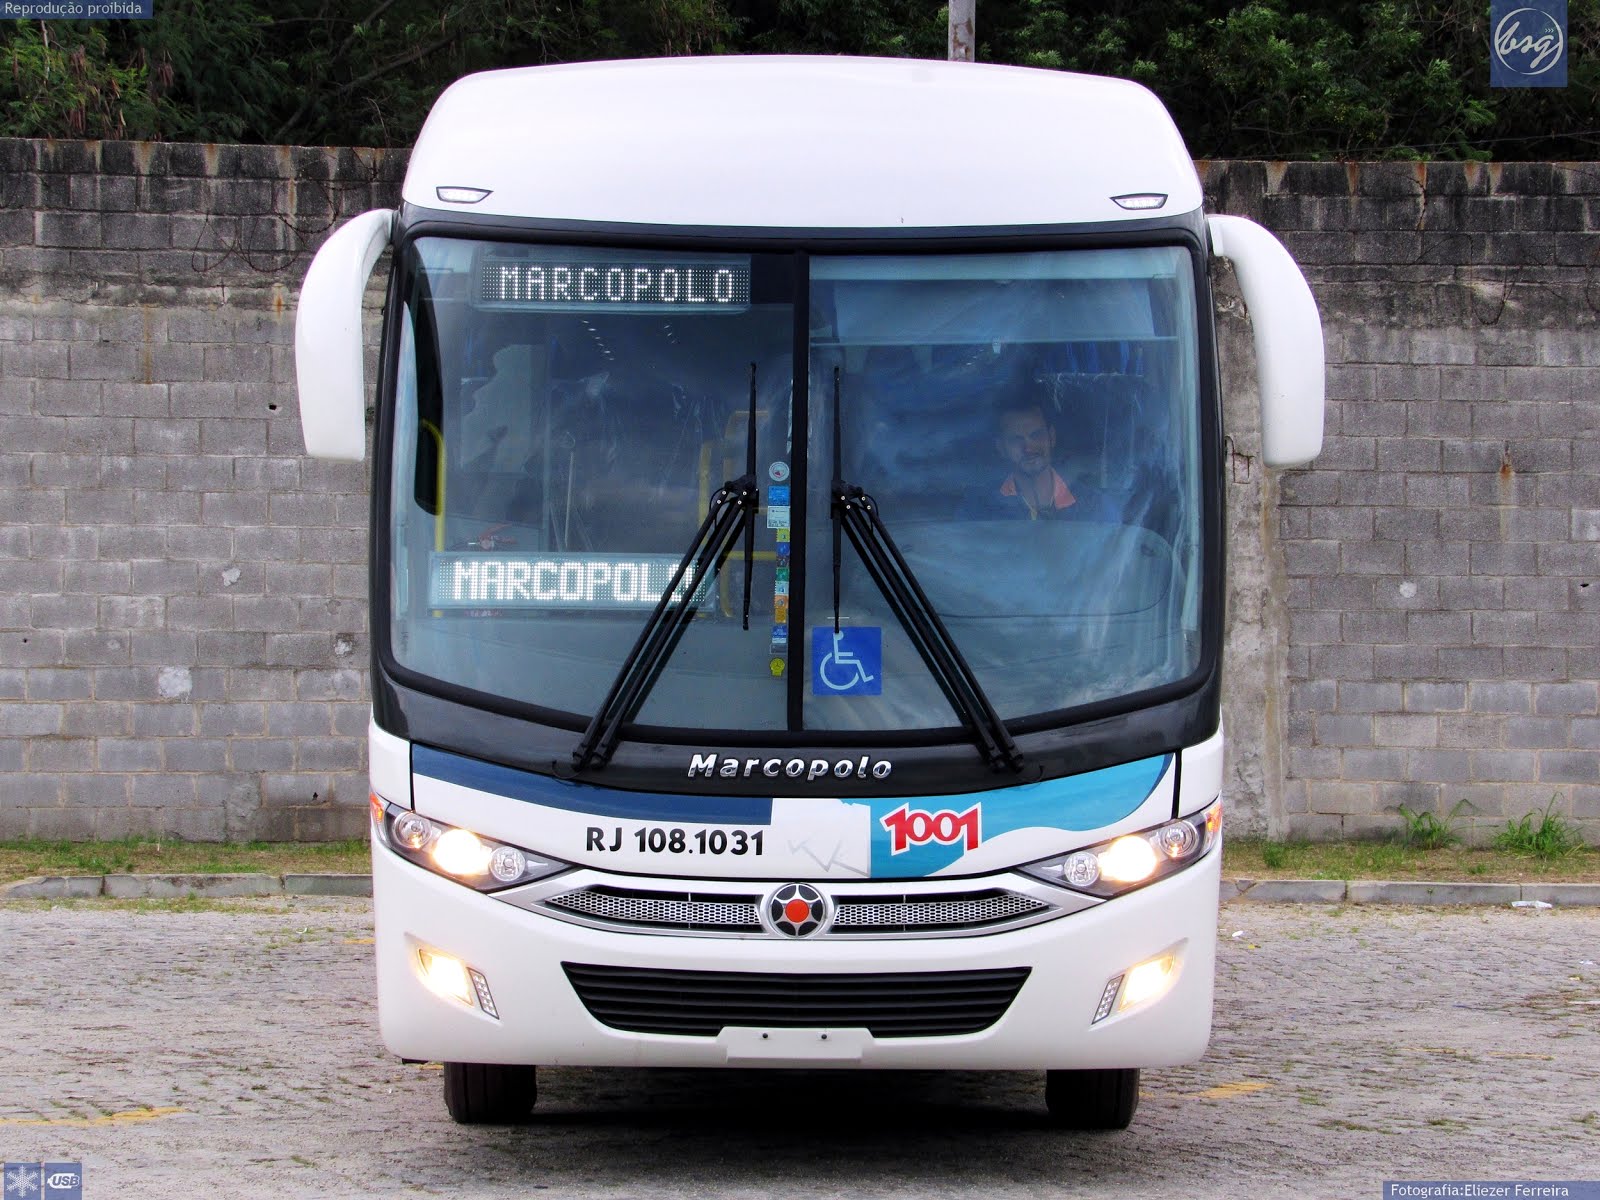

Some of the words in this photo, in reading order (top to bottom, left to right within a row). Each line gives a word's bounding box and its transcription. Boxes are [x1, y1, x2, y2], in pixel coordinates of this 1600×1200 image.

[500, 266, 734, 303] MARCOPOLO
[687, 753, 893, 781] Marcopolo
[586, 826, 623, 852] RJ
[633, 826, 764, 856] 108.1031
[879, 802, 982, 857] 1001
